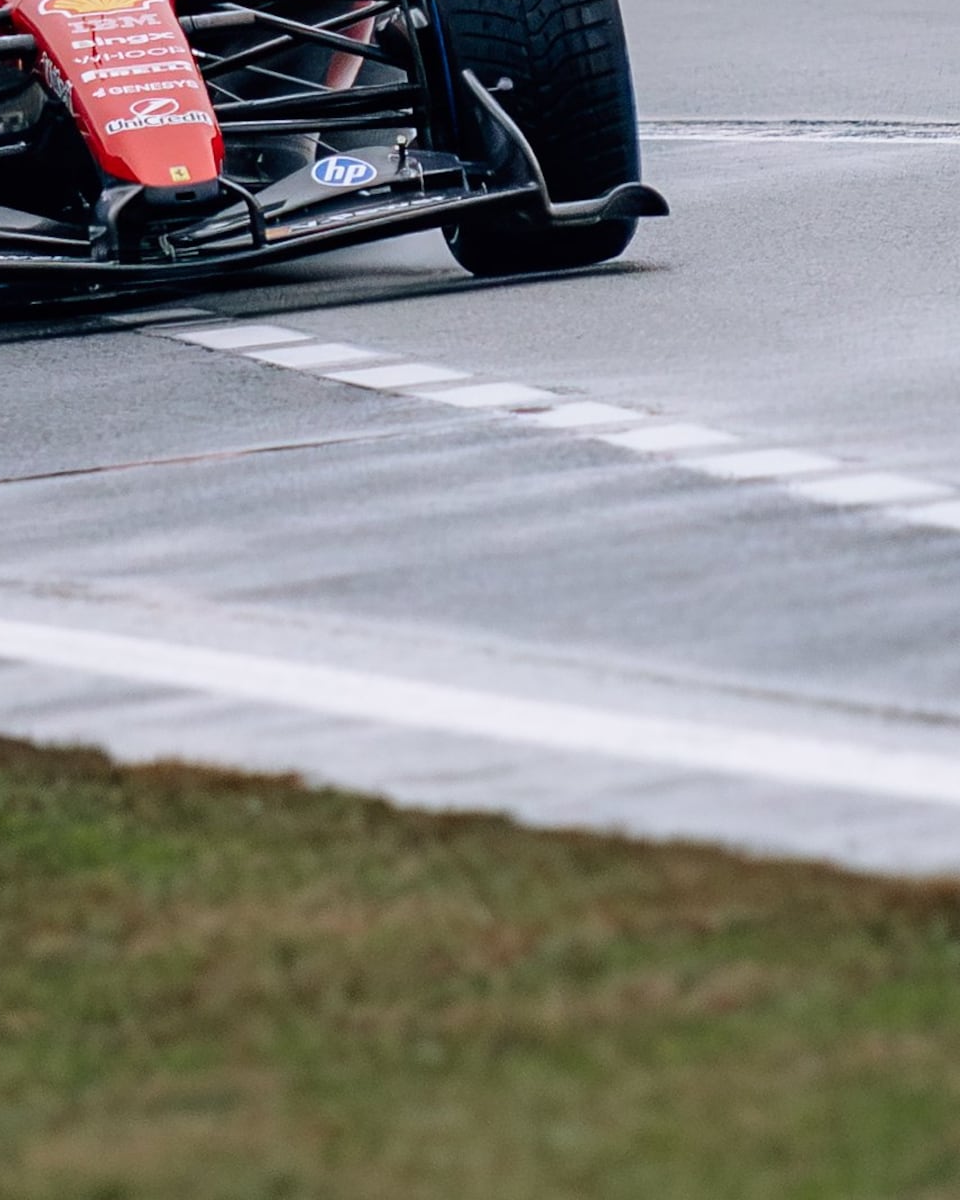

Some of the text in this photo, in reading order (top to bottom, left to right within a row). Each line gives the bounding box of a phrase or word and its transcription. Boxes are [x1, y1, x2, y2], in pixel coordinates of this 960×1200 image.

[68, 13, 161, 34] IBM
[108, 79, 199, 96] GENESYS
[106, 111, 212, 134] UniCredit
[324, 157, 366, 186] hp
